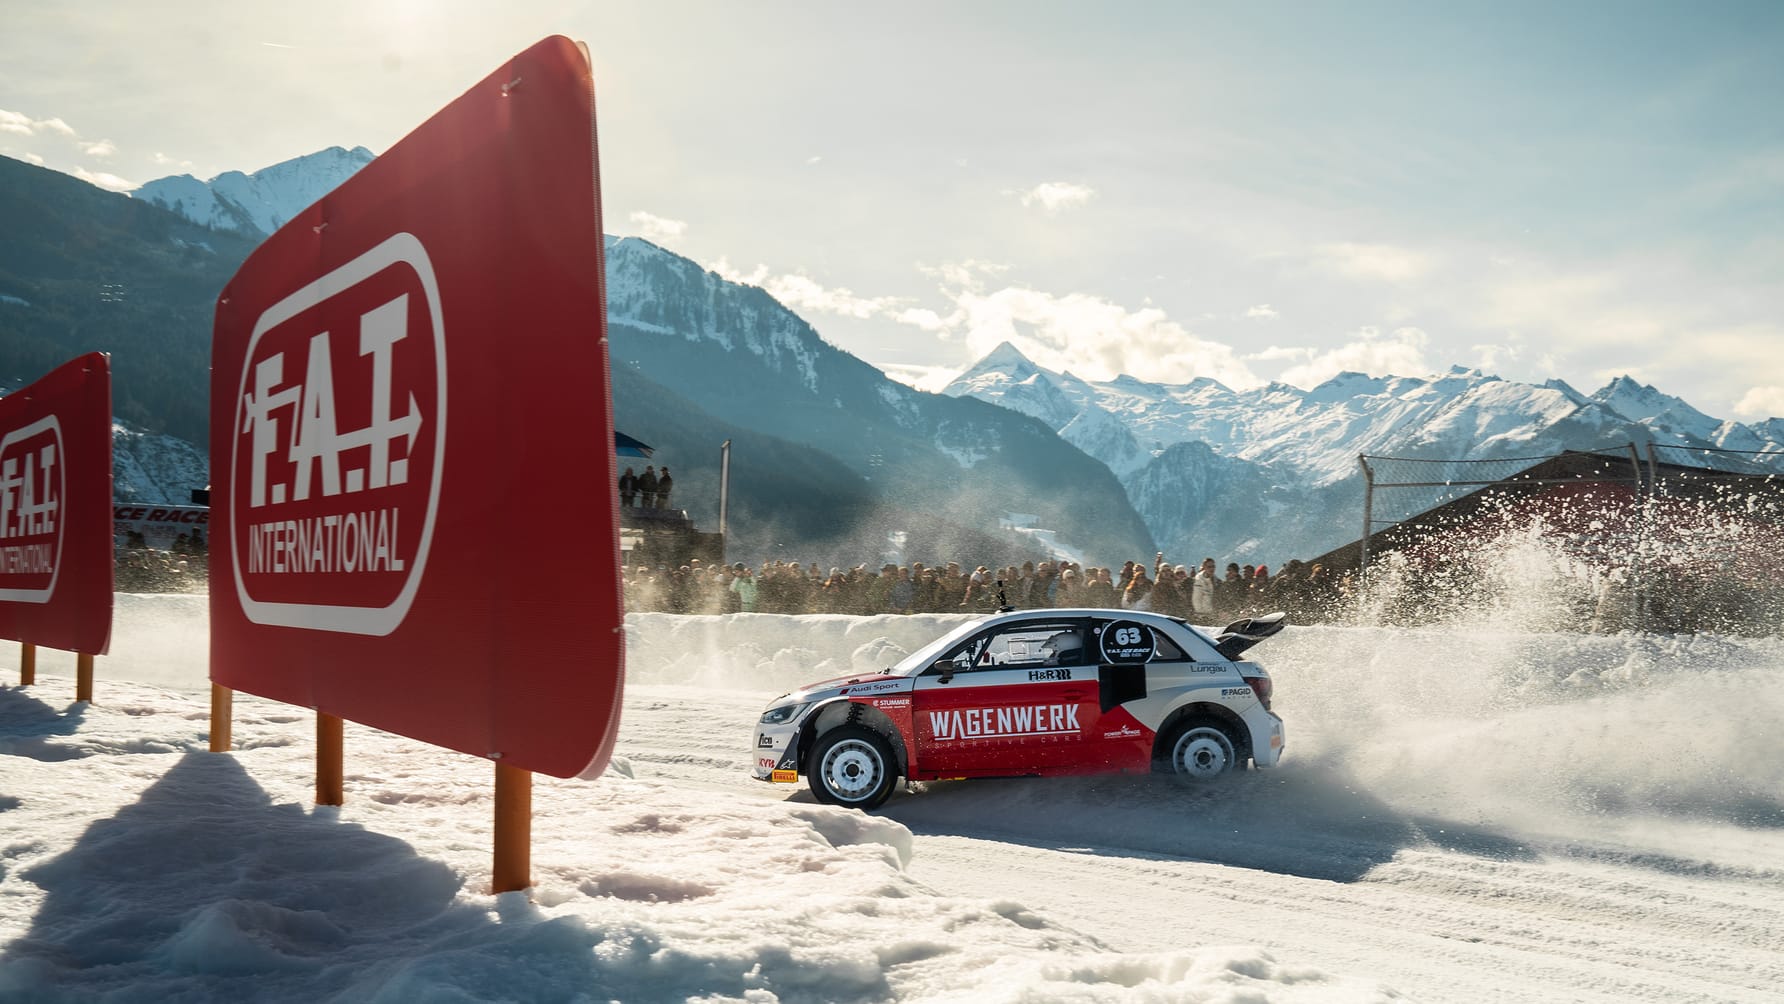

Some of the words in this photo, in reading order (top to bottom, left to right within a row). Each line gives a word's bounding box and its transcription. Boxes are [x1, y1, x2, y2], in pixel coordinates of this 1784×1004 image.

[113, 506, 147, 520] CE
[146, 508, 209, 524] RACE
[249, 508, 405, 574] INTERNATIONAL
[1115, 627, 1142, 646] 63
[1190, 664, 1227, 674] Lungau
[850, 685, 872, 693] Audi
[873, 683, 900, 691] Sport
[1228, 687, 1251, 696] PAGID
[929, 703, 1081, 740] WAGENWERK
[1041, 735, 1082, 744] CARS
